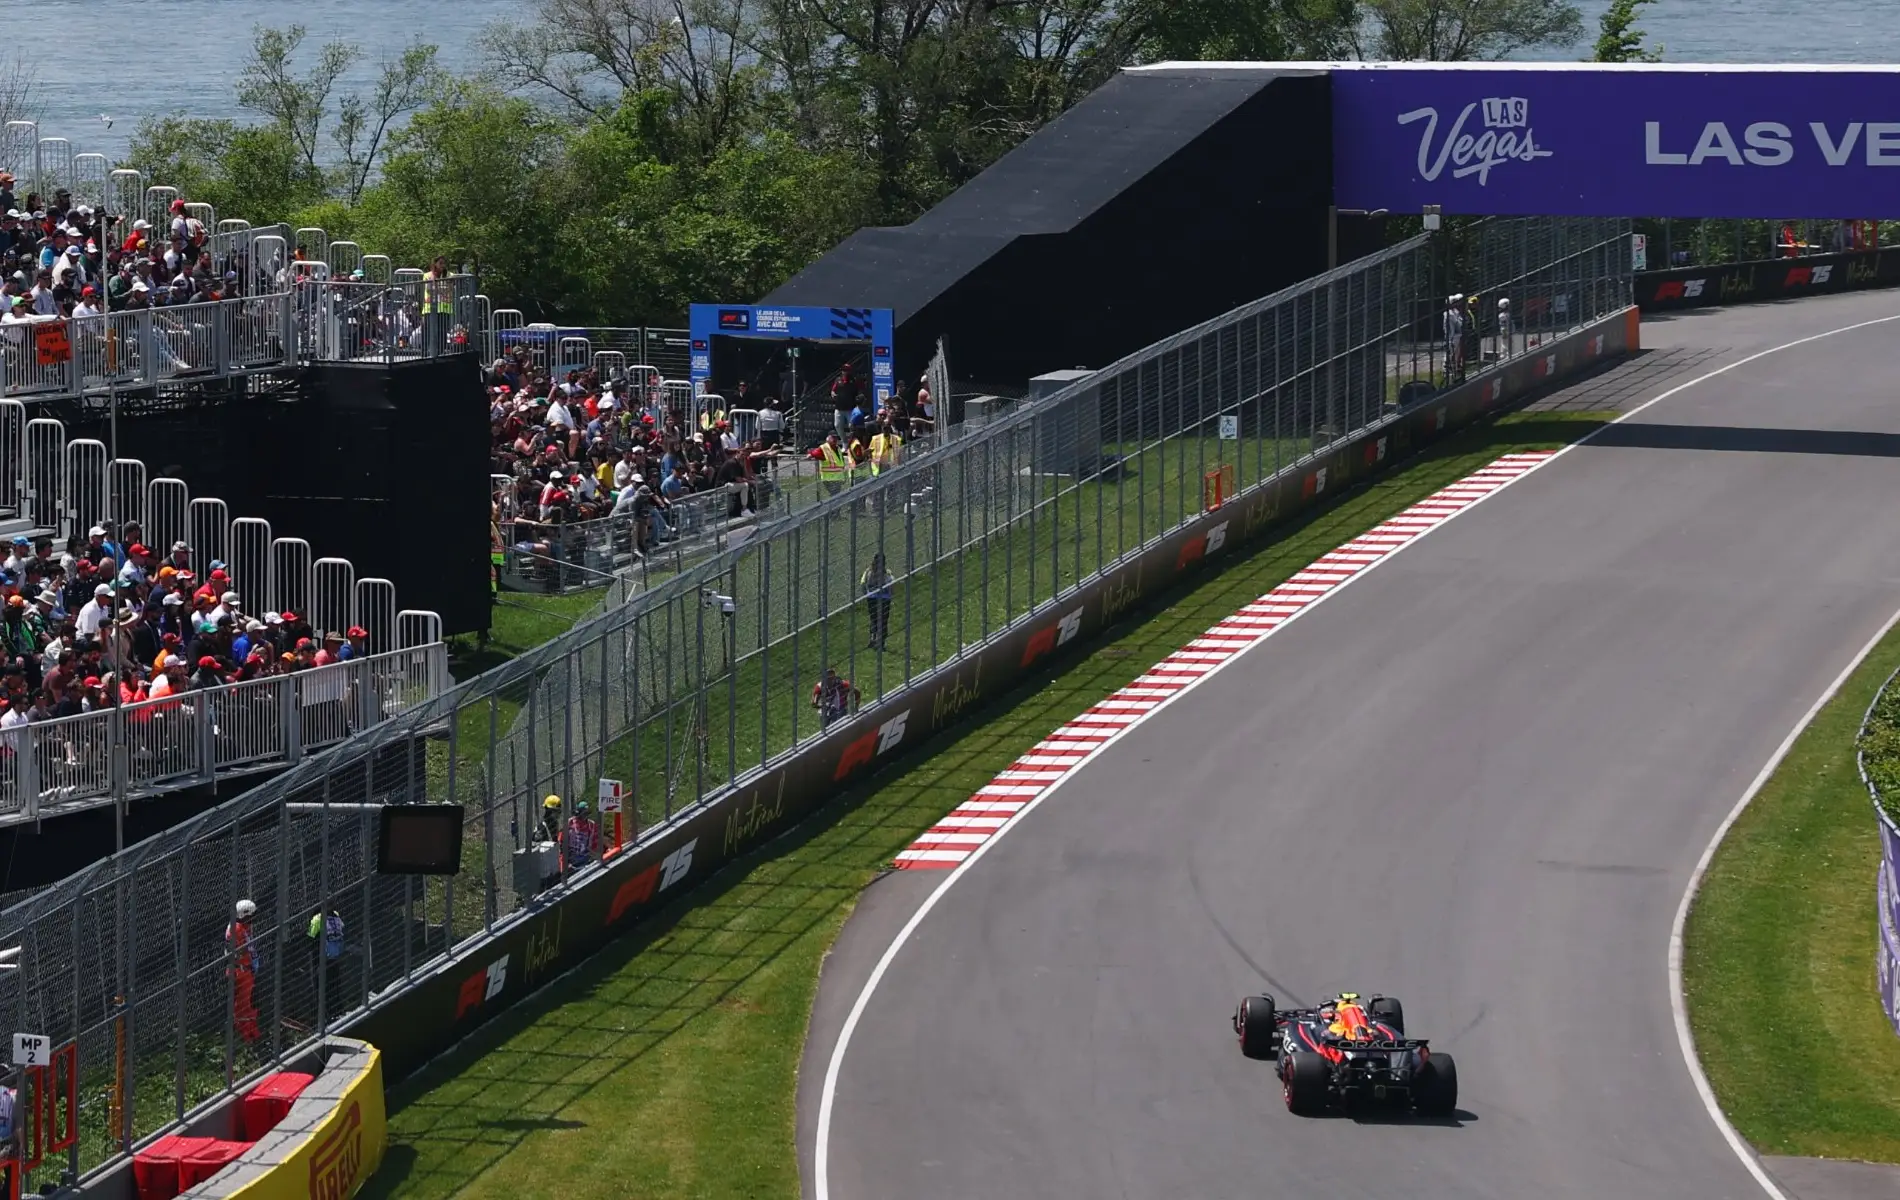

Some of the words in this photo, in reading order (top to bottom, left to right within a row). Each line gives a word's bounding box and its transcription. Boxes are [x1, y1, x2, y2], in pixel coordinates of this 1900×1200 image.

[1486, 101, 1524, 124] LAS
[1397, 102, 1554, 187] Vegas
[1645, 121, 1794, 166] LAS
[1808, 122, 1900, 166] VE
[601, 796, 620, 804] FIRE
[21, 1037, 42, 1050] MP
[1337, 1040, 1418, 1049] ORACLE
[27, 1051, 35, 1063] 2
